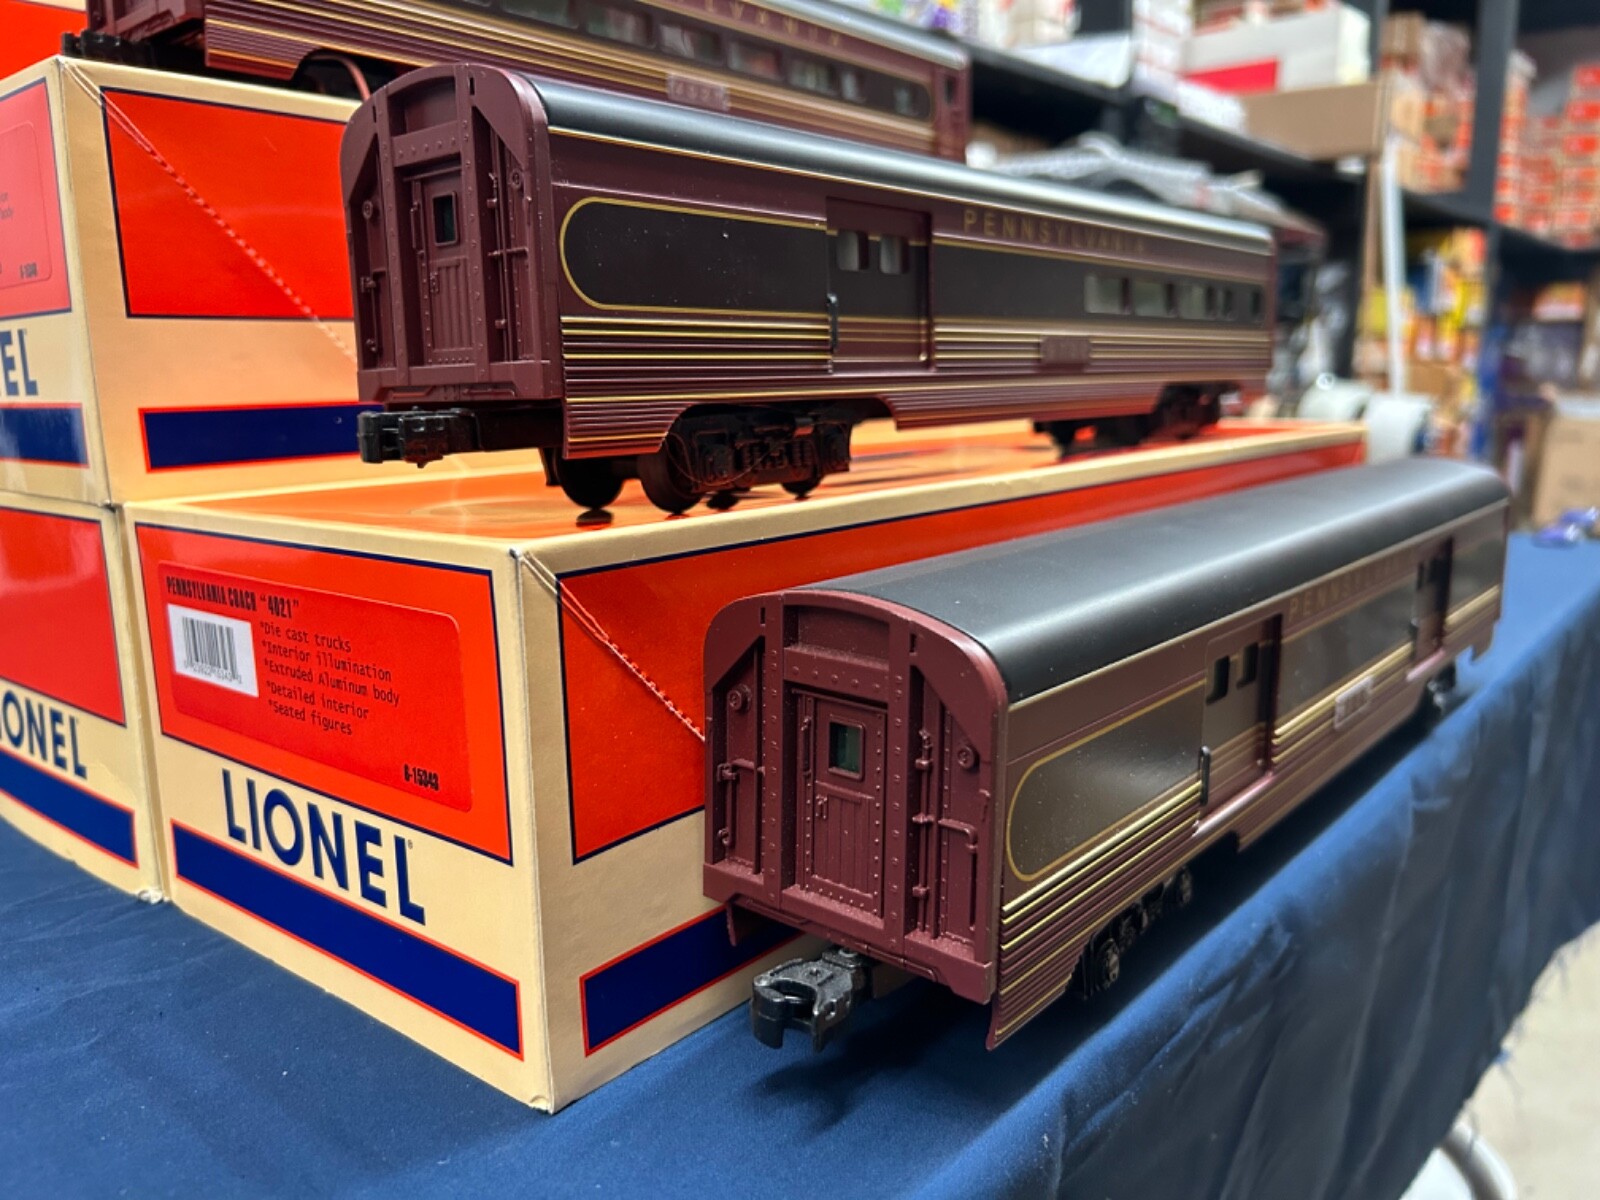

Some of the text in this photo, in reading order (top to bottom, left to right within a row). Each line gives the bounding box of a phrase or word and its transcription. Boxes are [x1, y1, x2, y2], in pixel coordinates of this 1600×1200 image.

[166, 575, 227, 605] PENNSYLVANIA
[228, 587, 257, 611] COACH
[285, 628, 309, 643] cast
[314, 634, 351, 653] trucks
[317, 651, 392, 682] illumination
[318, 671, 368, 696] Aluminum
[373, 684, 399, 707] body
[322, 693, 369, 719] interior
[311, 710, 352, 735] figures
[222, 768, 426, 926] LIONEL
